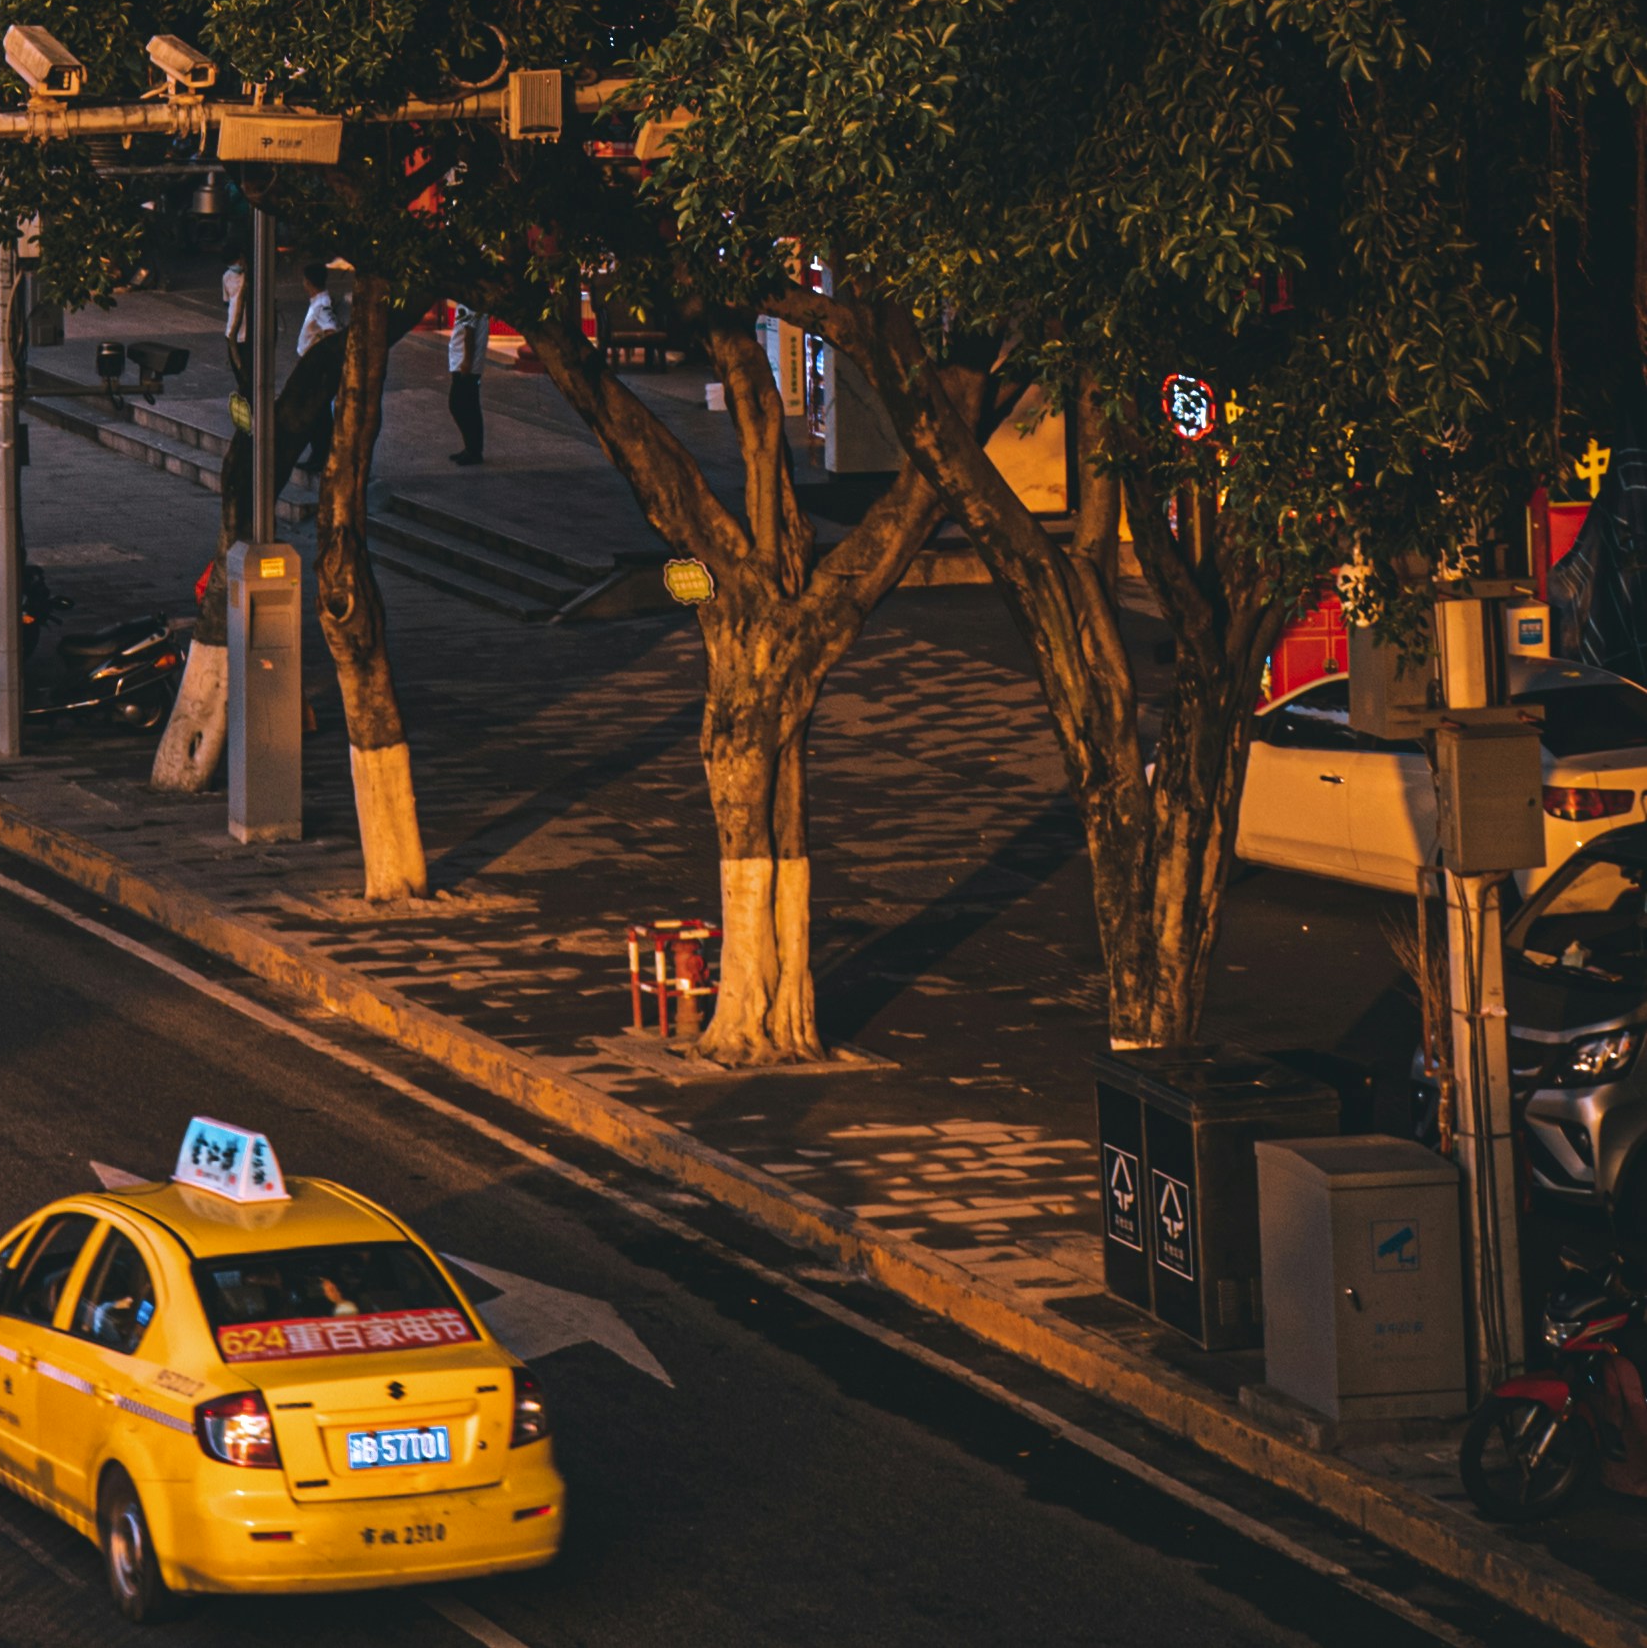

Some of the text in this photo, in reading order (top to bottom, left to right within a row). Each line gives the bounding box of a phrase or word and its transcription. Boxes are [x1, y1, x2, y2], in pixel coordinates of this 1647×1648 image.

[220, 1310, 468, 1356] 624重百家电节
